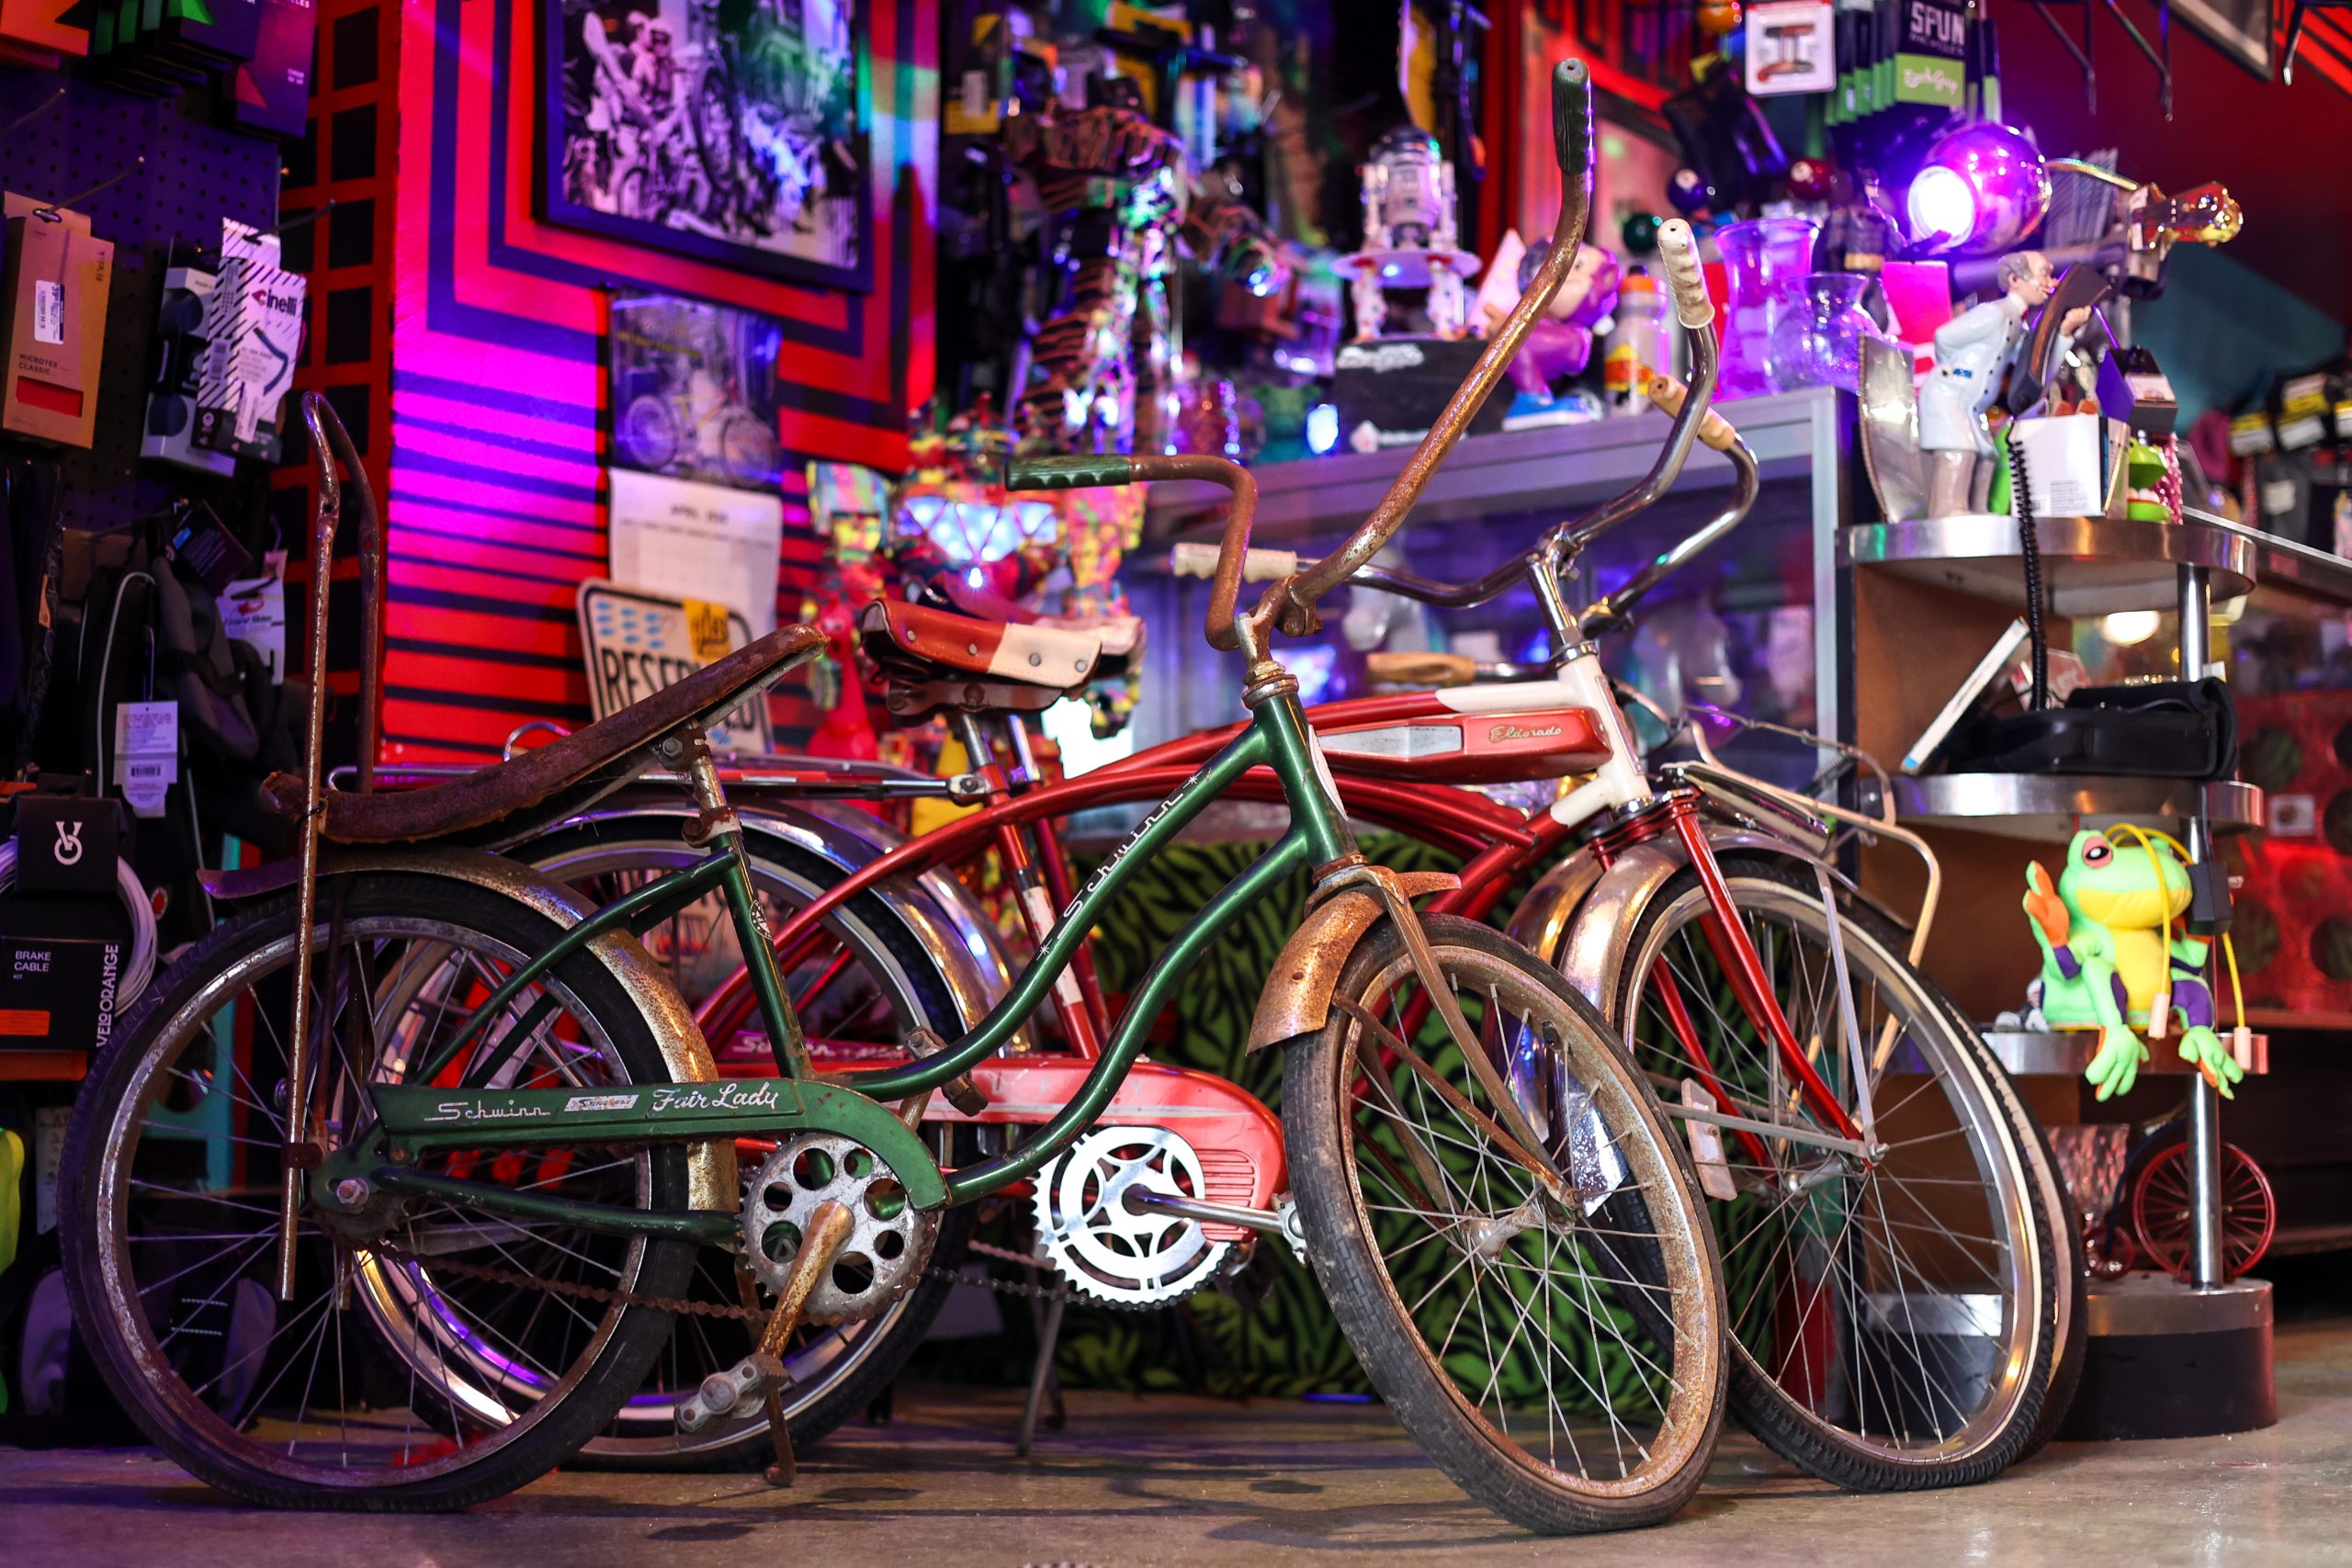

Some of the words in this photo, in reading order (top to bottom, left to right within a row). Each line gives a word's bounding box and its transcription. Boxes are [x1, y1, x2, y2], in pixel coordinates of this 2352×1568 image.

[1910, 1, 1965, 45] SPUN
[1489, 725, 1562, 743] Eldorado
[1057, 793, 1184, 941] Schwinn
[14, 962, 50, 973] CABLE
[15, 950, 51, 962] BRAKE
[424, 1099, 551, 1122] Schwinn
[652, 1088, 710, 1111] Fair
[711, 1082, 779, 1110] Lady
